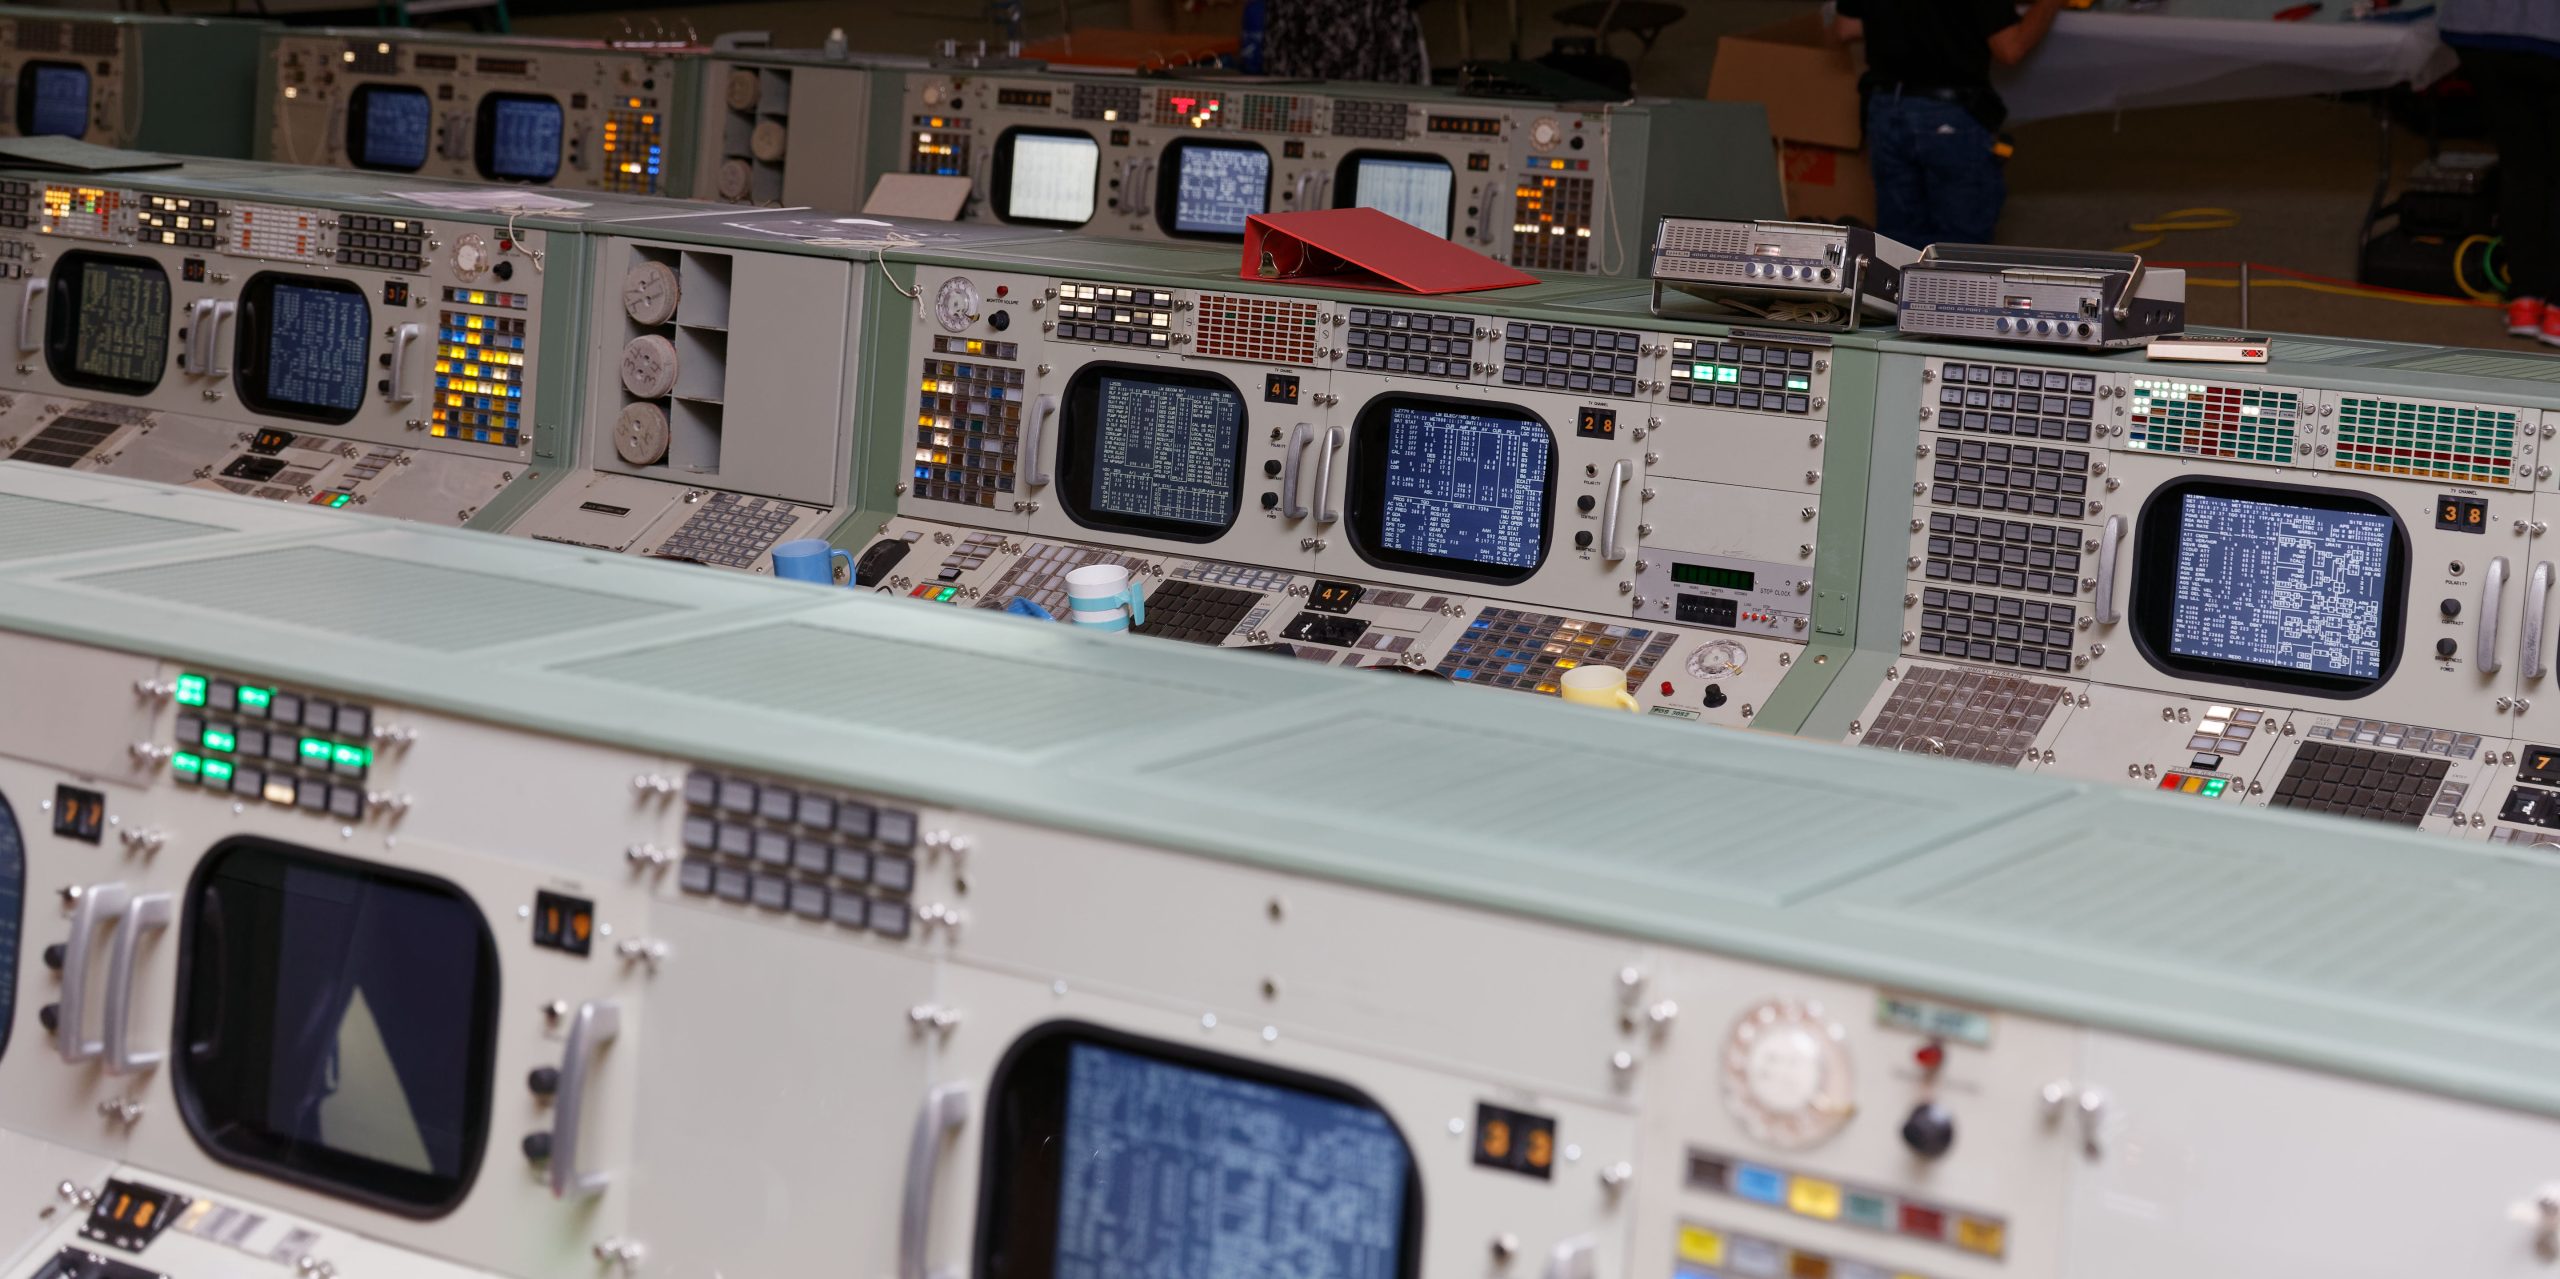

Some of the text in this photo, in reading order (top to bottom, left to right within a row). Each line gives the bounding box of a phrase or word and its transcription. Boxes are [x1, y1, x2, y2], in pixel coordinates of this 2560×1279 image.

[1584, 416, 1612, 432] 28
[2444, 505, 2480, 524] 38
[1322, 588, 1349, 602] 47
